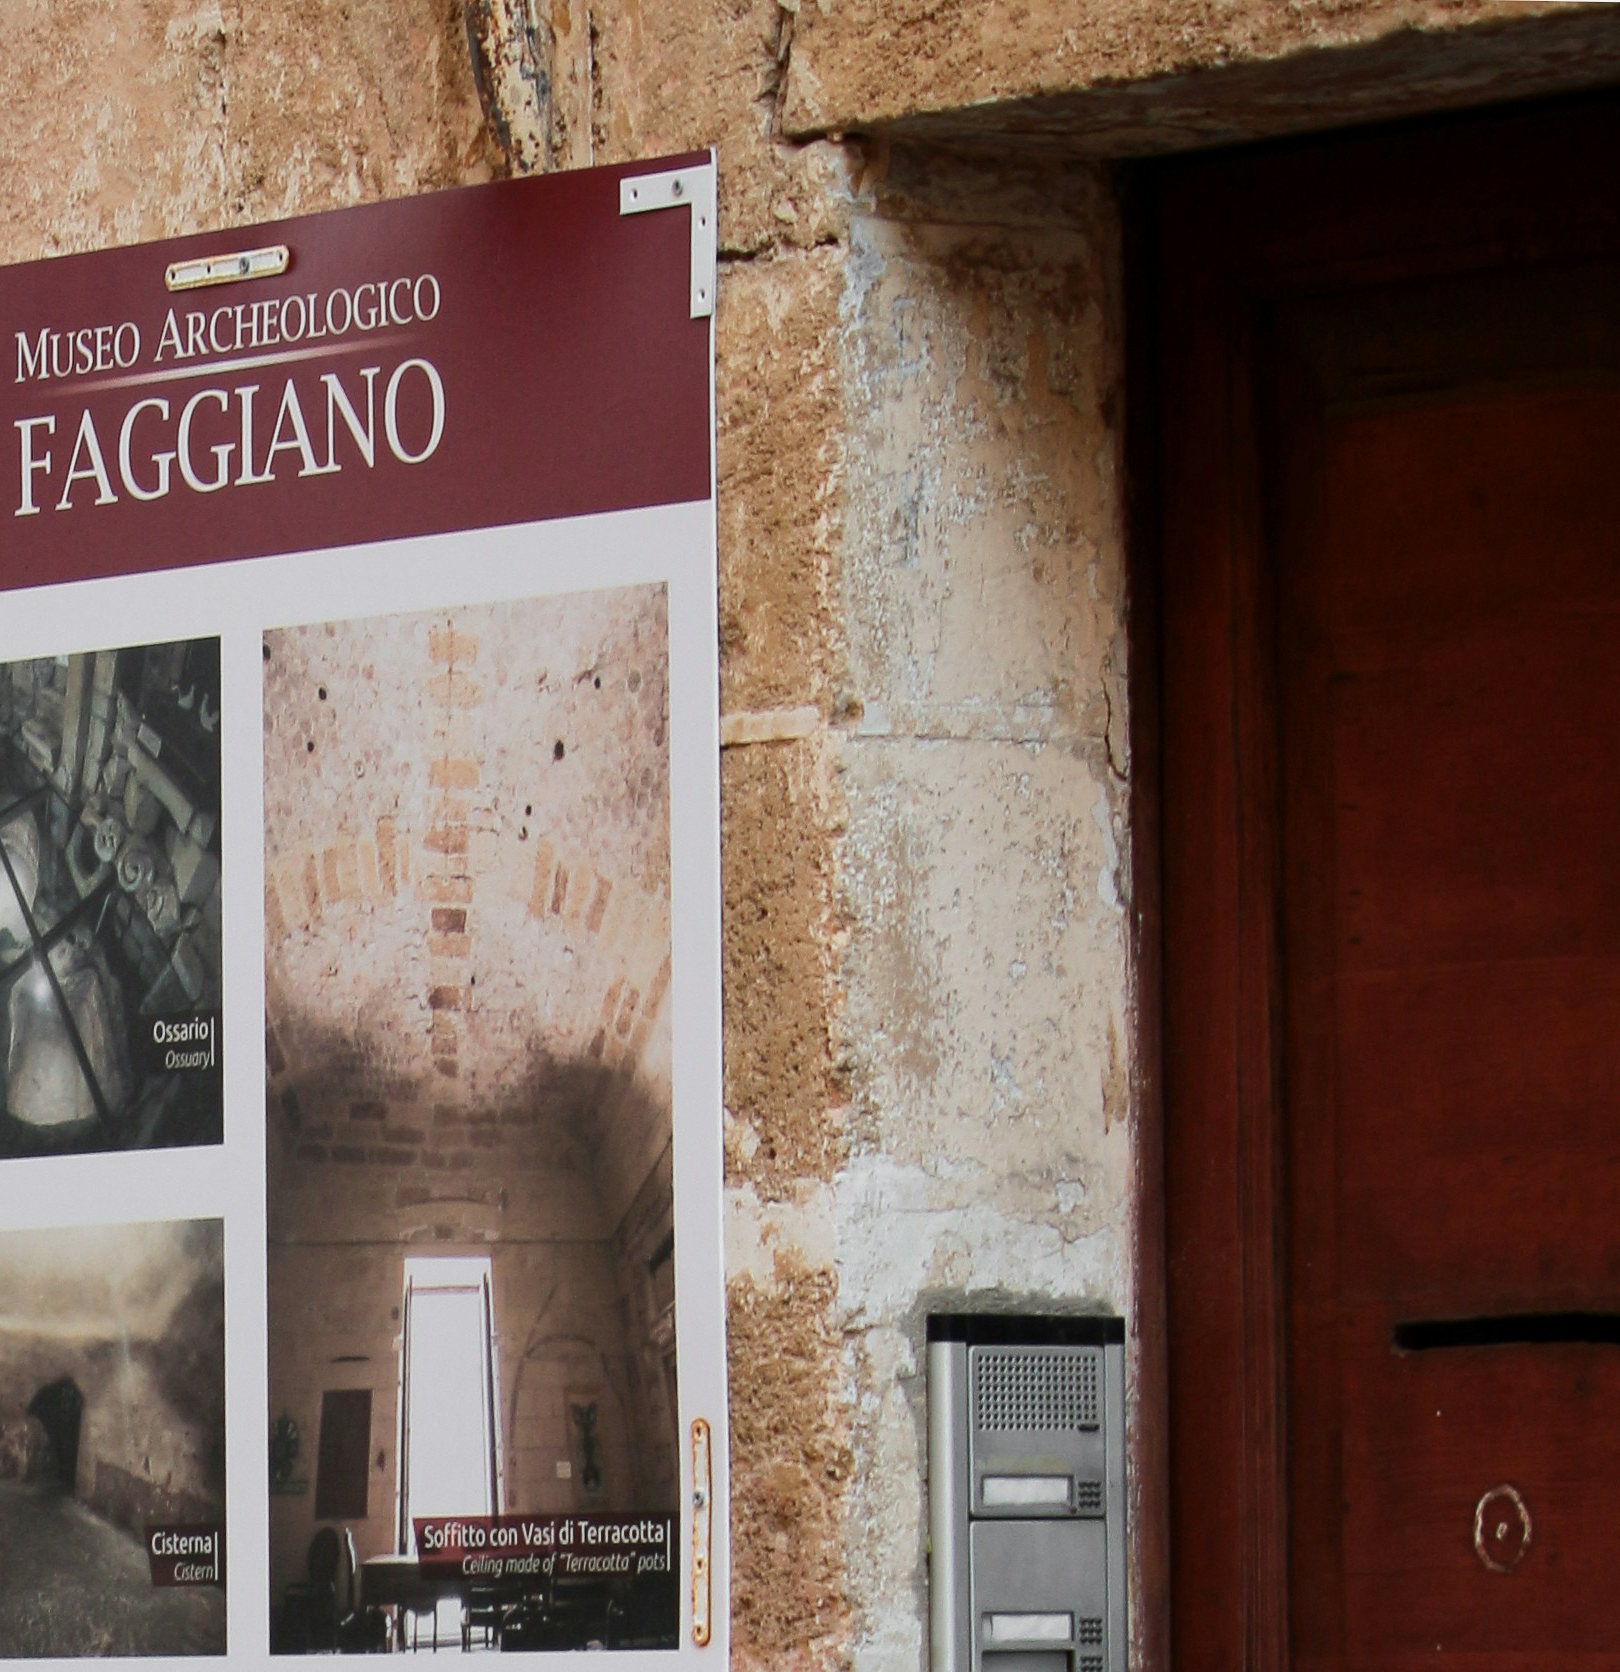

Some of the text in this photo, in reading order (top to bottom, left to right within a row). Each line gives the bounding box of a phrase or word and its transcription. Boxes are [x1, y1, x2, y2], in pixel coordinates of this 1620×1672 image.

[14, 273, 441, 383] MUSEO ARCHEOLOGICO
[13, 358, 446, 516] FAGGIANO
[153, 1016, 209, 1044] Ossario
[165, 1050, 210, 1070] Ossuary
[151, 1531, 212, 1555] Cisterna
[424, 1520, 664, 1549] Soffitto con Vasi di Terracotta
[174, 1561, 213, 1581] Cistern
[462, 1555, 503, 1578] Ceiling
[505, 1554, 541, 1573] made
[542, 1551, 557, 1576] of
[637, 1551, 665, 1574] pots
